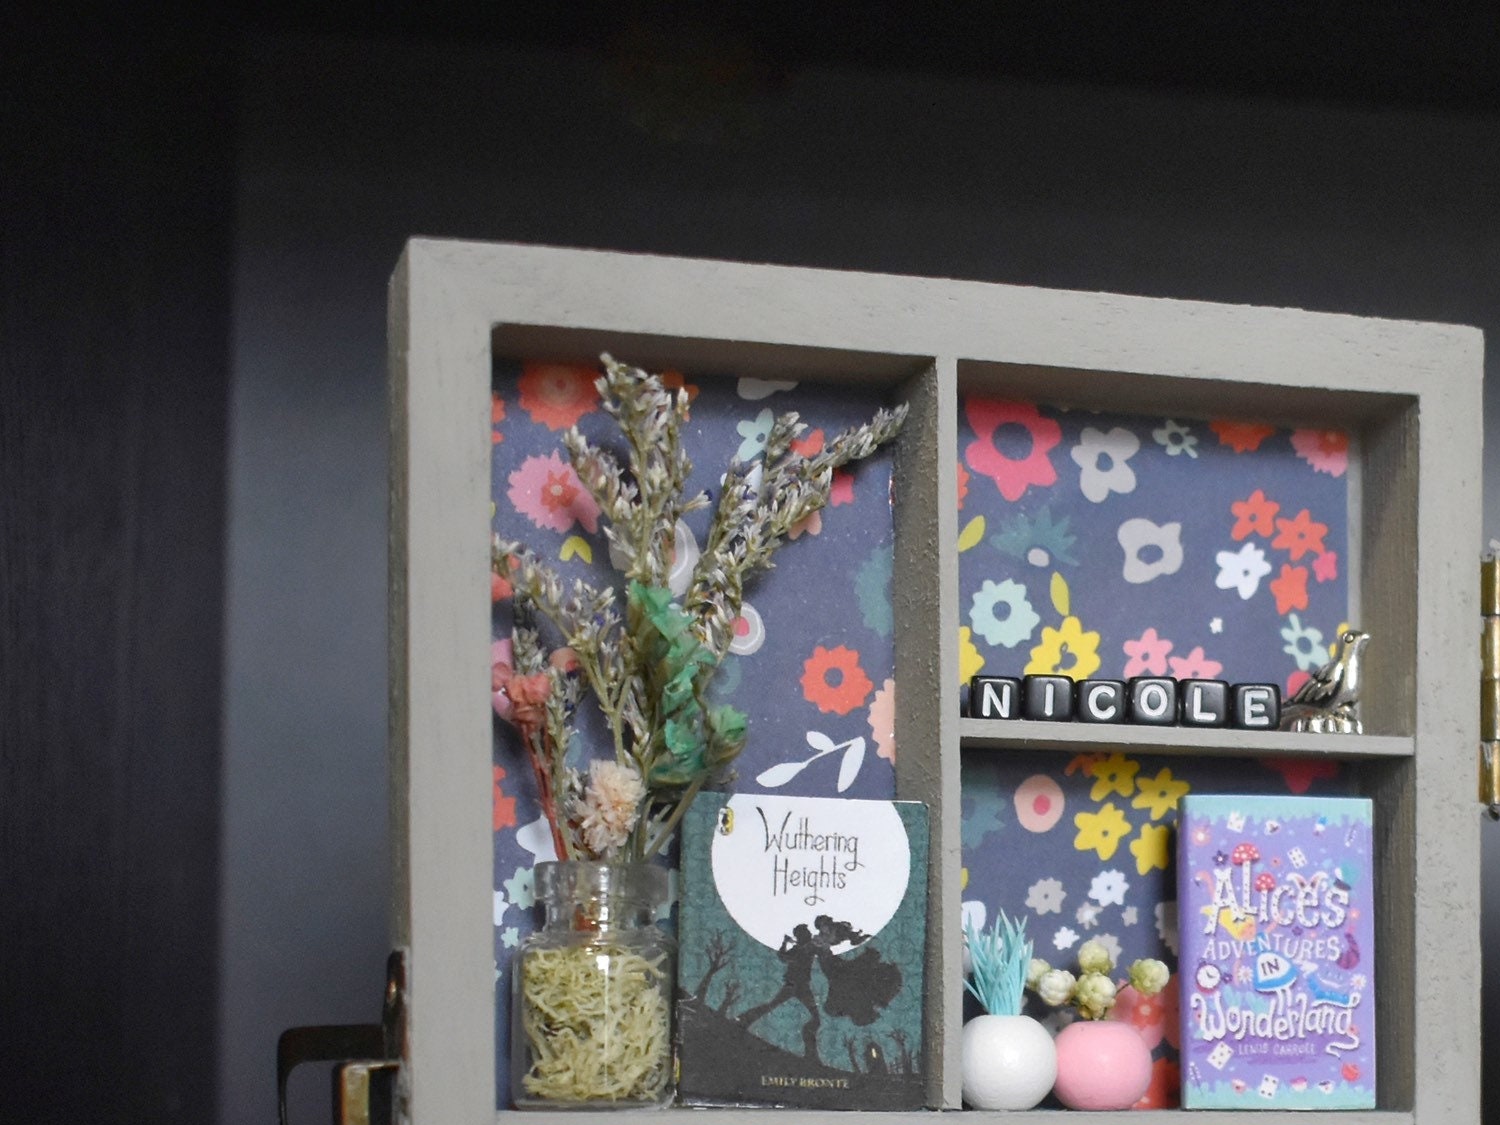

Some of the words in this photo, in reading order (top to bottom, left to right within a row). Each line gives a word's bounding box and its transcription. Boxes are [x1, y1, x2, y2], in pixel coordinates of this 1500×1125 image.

[982, 682, 1271, 726] NICOLE
[756, 806, 865, 870] Wuthering
[773, 855, 848, 906] Heights
[1203, 935, 1343, 963] ADVENTURES
[1260, 953, 1283, 977] IN
[1191, 993, 1362, 1059] Wonderland
[761, 1075, 797, 1087] EMILY
